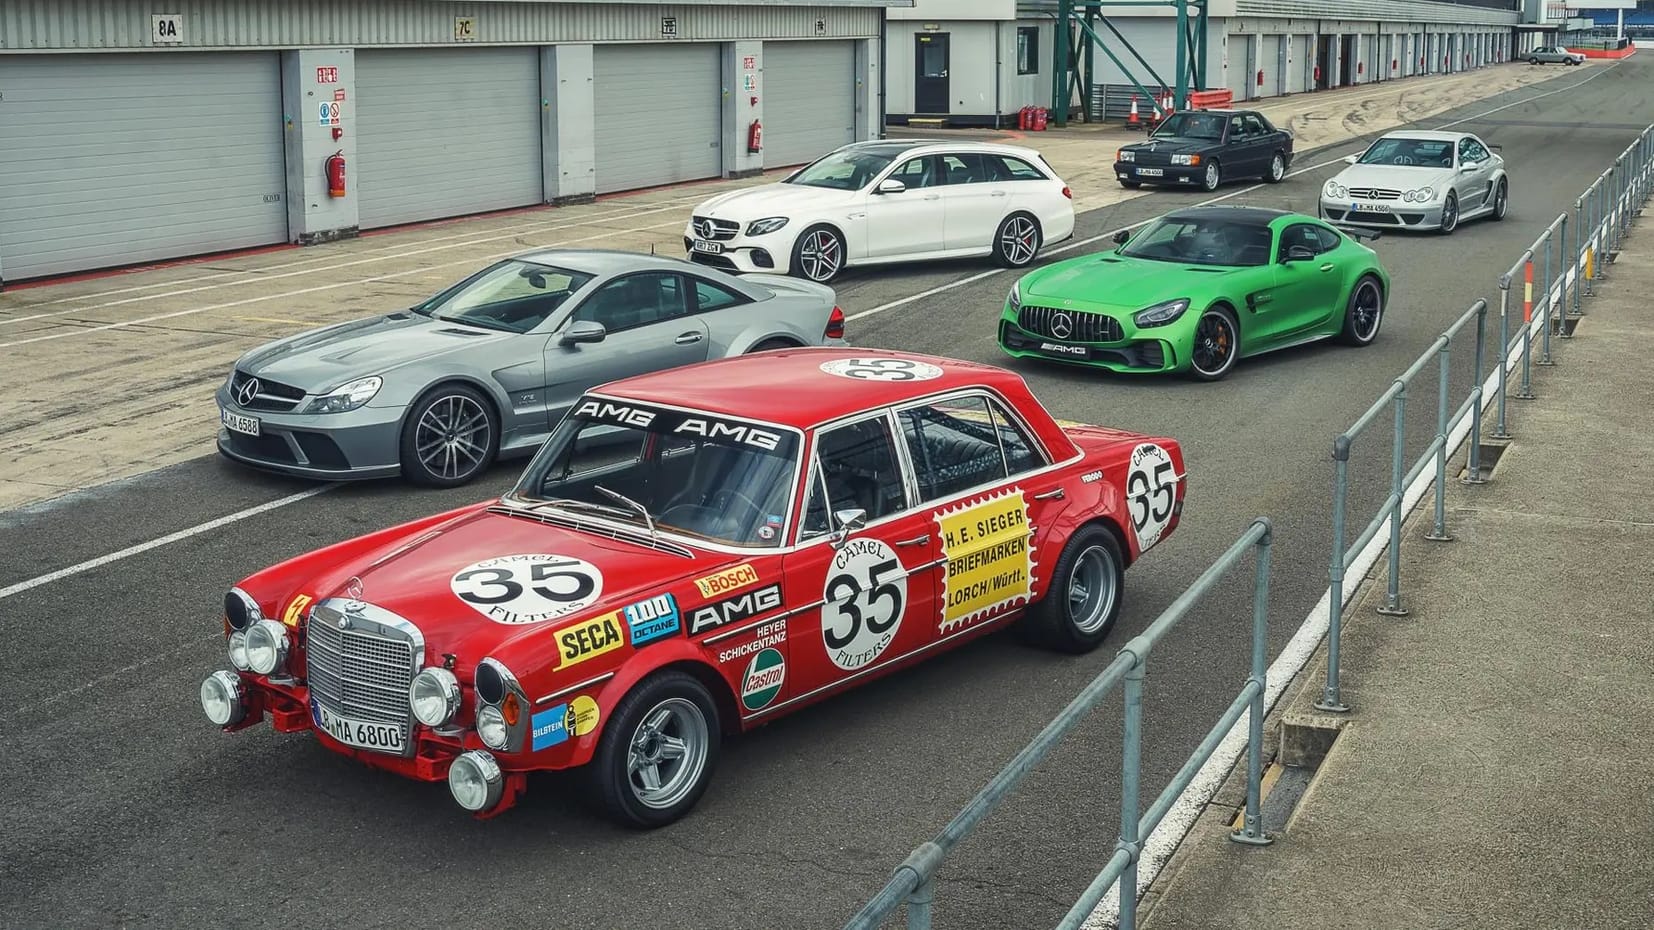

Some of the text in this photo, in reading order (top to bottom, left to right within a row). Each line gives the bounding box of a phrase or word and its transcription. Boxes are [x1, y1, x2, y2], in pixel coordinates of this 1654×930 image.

[159, 20, 177, 36] 8A
[459, 20, 471, 35] 7C
[1053, 345, 1086, 355] AMG
[238, 417, 258, 434] 6588
[574, 401, 782, 451] AMG AMG
[1128, 461, 1173, 533] 35
[945, 507, 1024, 549] H.E. SIEGER
[836, 541, 886, 570] CAMEL
[948, 536, 1026, 578] BRIEFMARKEN
[455, 560, 595, 605] 35
[708, 566, 756, 593] BOSCH
[947, 567, 1026, 609] LORCH/Württ.
[487, 601, 585, 623] FILTERS
[627, 594, 673, 626] 100
[691, 585, 782, 634] AMG
[824, 558, 902, 650] 35
[561, 618, 621, 660] SECA
[633, 618, 676, 640] OCTANE
[756, 619, 787, 638] HEYER
[719, 631, 787, 664] SCHICKENTANZ
[836, 632, 892, 668] FILTERS
[745, 665, 782, 693] Castrol
[335, 718, 353, 742] MA
[357, 724, 400, 748] 6800
[532, 718, 564, 738] BILSTEIN
